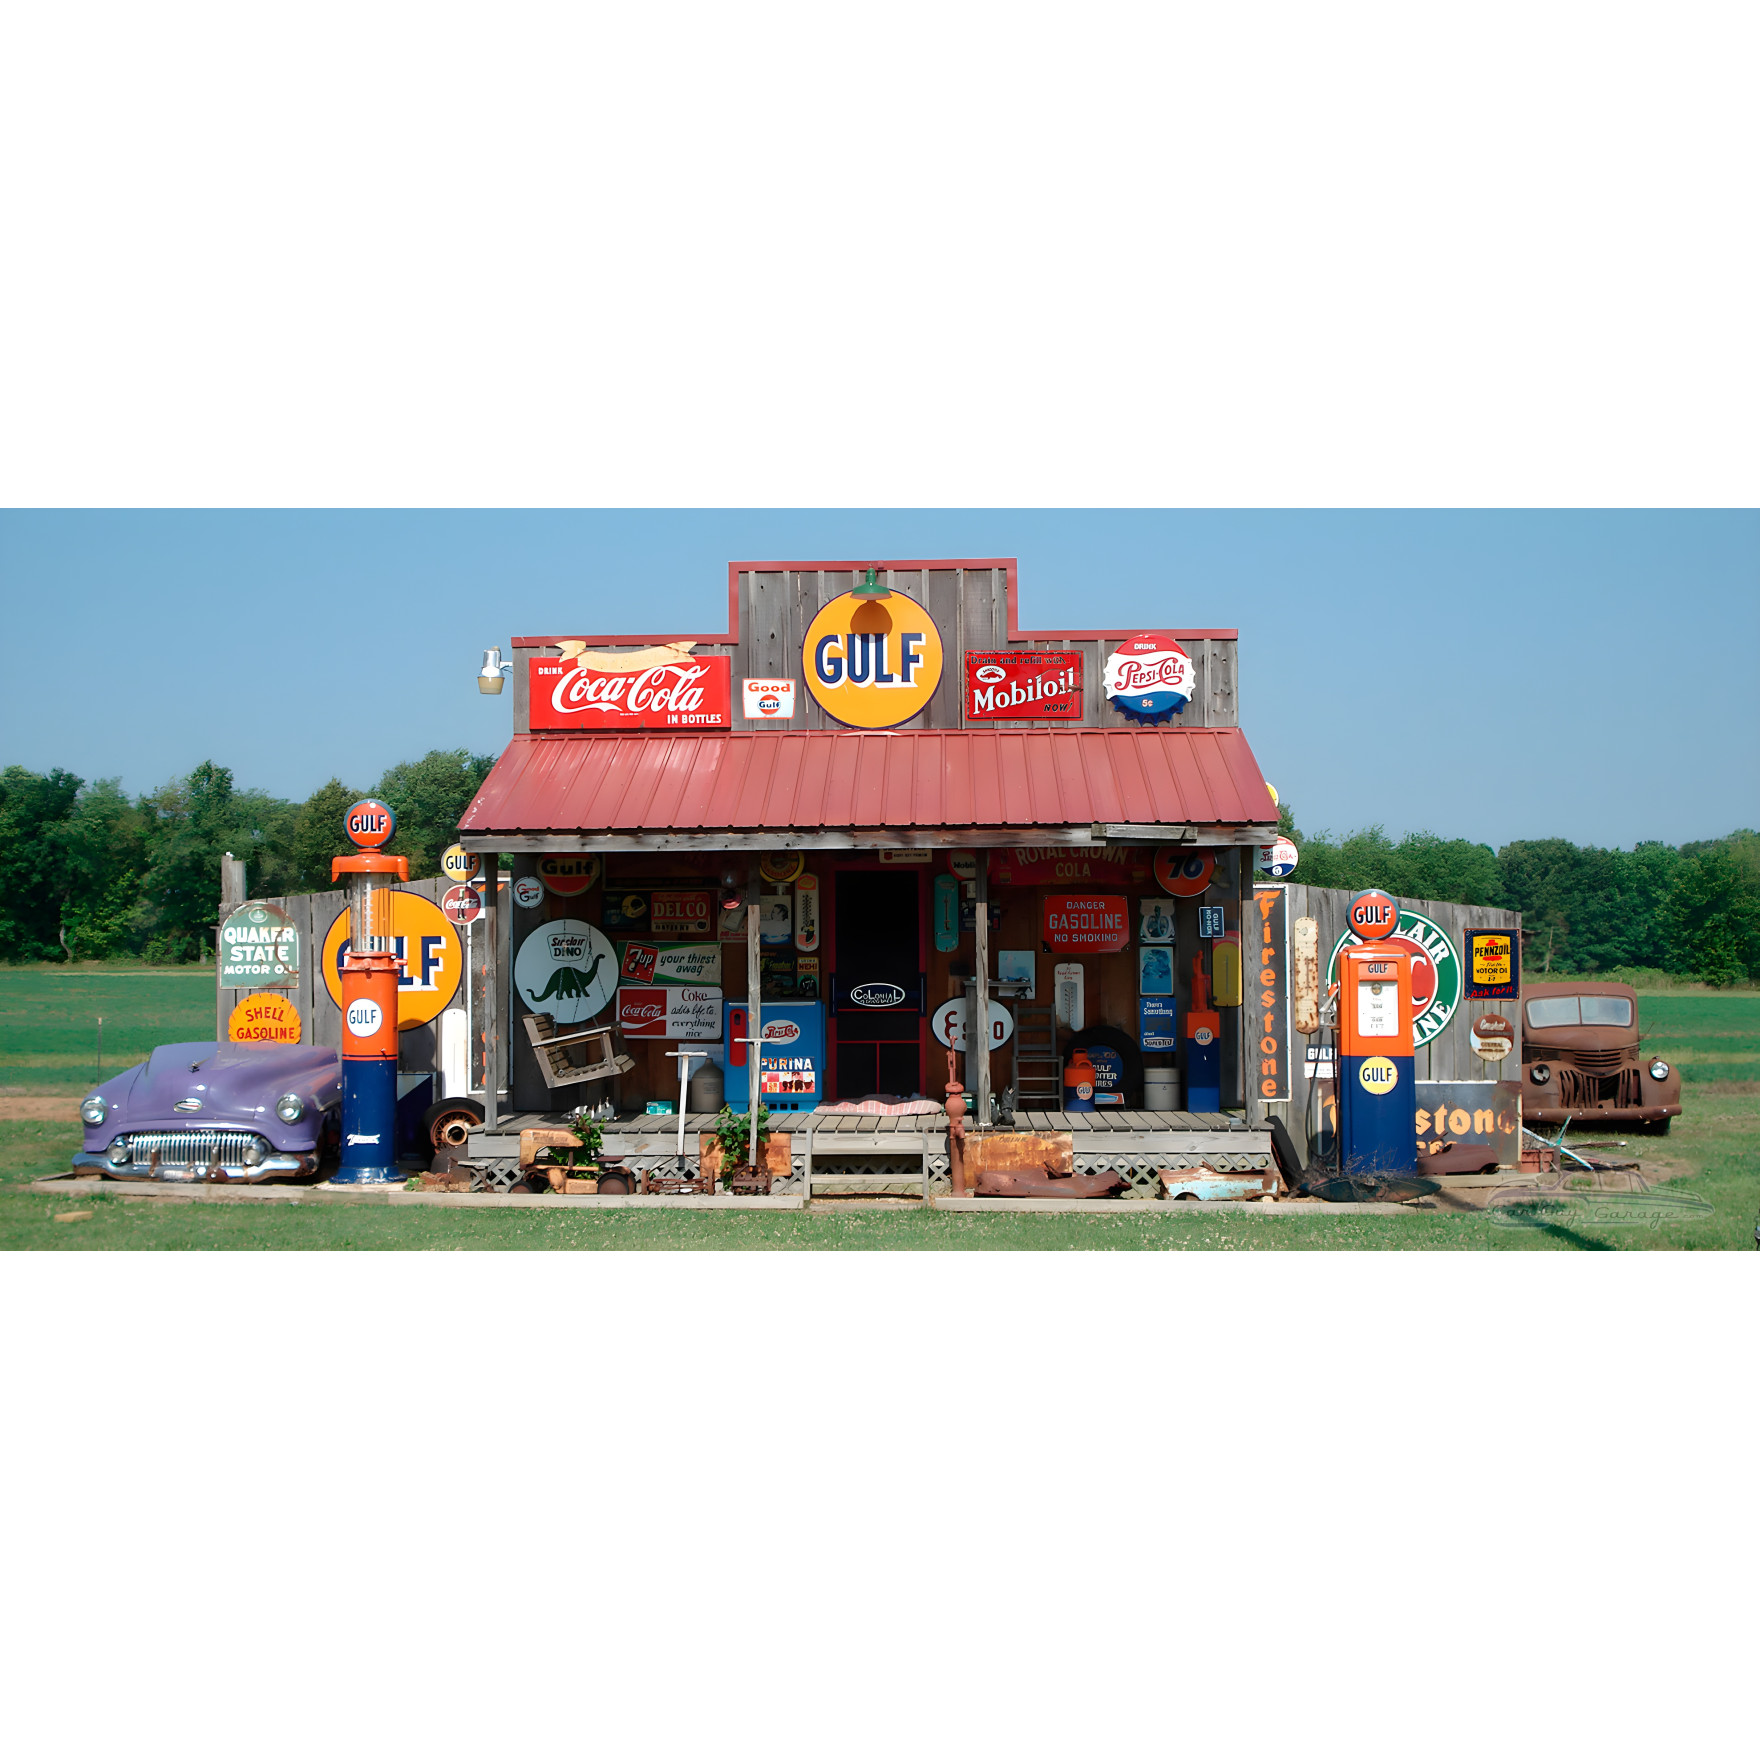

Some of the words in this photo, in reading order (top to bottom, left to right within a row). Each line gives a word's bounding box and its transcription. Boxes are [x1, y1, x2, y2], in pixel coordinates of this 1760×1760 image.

[815, 632, 927, 688] GULF
[971, 656, 997, 664] Drain
[1000, 656, 1017, 664] and
[1020, 656, 1042, 664] refill
[538, 667, 563, 676] DRINK
[551, 665, 711, 713] Coca-Cola
[748, 682, 791, 692] Good
[973, 667, 1074, 715] Mobiloil
[758, 701, 781, 709] Gulf
[667, 714, 679, 724] IN
[681, 713, 722, 724] BOTTLES
[349, 814, 388, 834] GULF
[445, 855, 477, 871] GULF
[541, 859, 593, 875] Gulf
[1055, 862, 1092, 877] COLA
[1168, 851, 1205, 879] 76
[516, 883, 540, 894] Good
[519, 891, 540, 902] Gulf
[653, 902, 707, 917] DELCO
[1066, 901, 1106, 910] DANGER
[1049, 913, 1123, 930] GASOLINE
[1354, 906, 1392, 925] GULF
[224, 927, 295, 945] QUAKER
[551, 937, 586, 946] Sinclair
[1054, 933, 1068, 942] NO
[1072, 933, 1118, 943] SMOKING
[230, 946, 289, 962] STATE
[554, 947, 582, 956] DINO
[1474, 944, 1510, 957] PENNZOIL
[660, 954, 685, 966] your
[687, 953, 716, 964] thirst
[224, 965, 271, 975] MOTOR
[676, 965, 704, 976] away
[1368, 964, 1389, 974] GULF
[681, 988, 708, 1002] Coke
[1253, 890, 1281, 1097] Firestone
[1470, 988, 1490, 998] Ask
[245, 1006, 285, 1022] SHELL
[349, 1009, 377, 1024] GULF
[622, 1004, 664, 1017] Coca-Cola
[672, 1020, 716, 1030] everything
[236, 1027, 295, 1040] GASOLINE
[1196, 1031, 1211, 1040] GULF
[761, 1057, 813, 1071] PURINA
[1363, 1068, 1393, 1082] GULF
